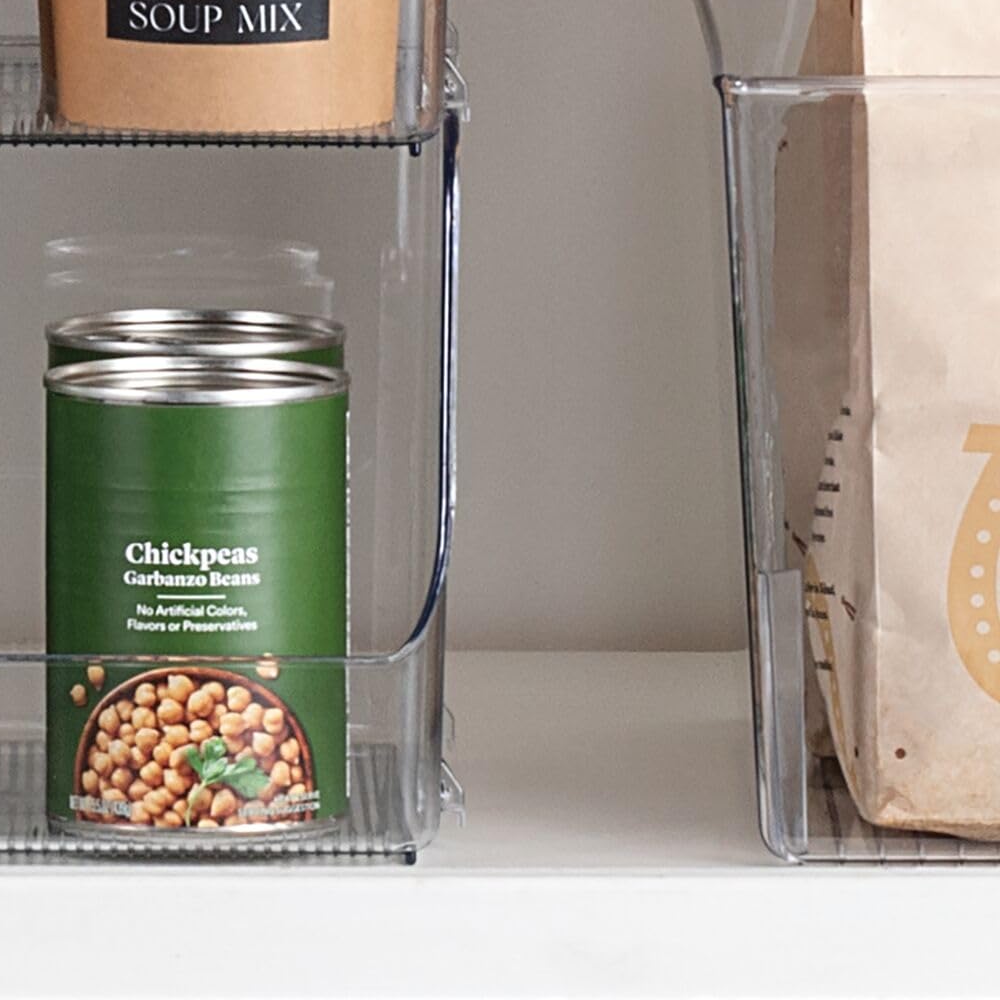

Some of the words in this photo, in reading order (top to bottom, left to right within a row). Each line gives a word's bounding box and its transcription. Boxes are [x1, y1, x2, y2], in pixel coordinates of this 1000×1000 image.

[129, 0, 223, 33] SOUP
[237, 2, 303, 34] MIX
[125, 541, 259, 571] Chickpeas
[123, 570, 208, 587] Garbanzo
[209, 571, 261, 587] Beans
[136, 604, 154, 616] No
[155, 604, 205, 617] Artificial
[206, 604, 248, 618] Colors,
[127, 618, 166, 631] Flavors
[168, 621, 180, 631] or
[182, 619, 258, 632] Preservatives
